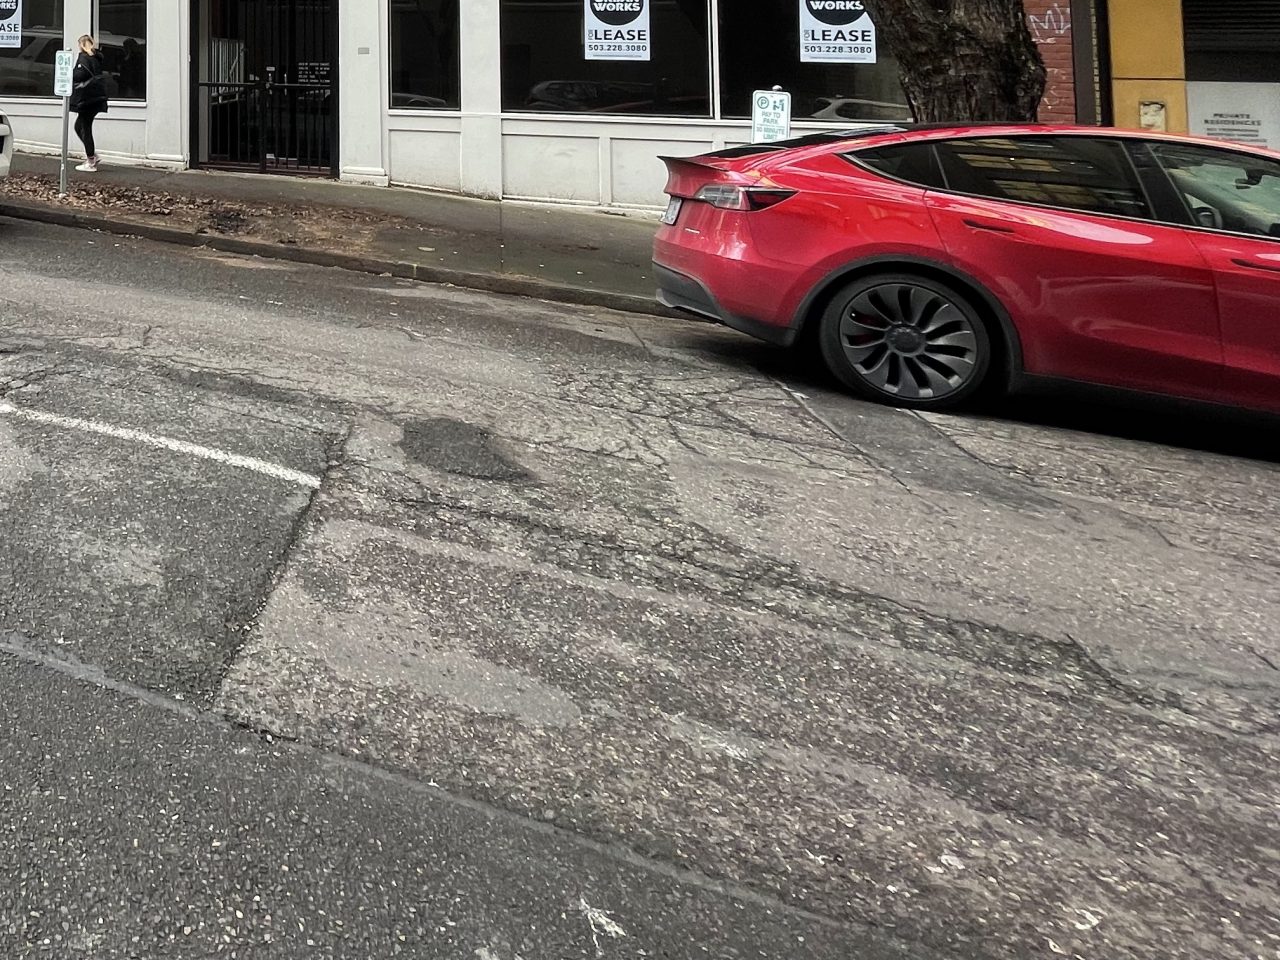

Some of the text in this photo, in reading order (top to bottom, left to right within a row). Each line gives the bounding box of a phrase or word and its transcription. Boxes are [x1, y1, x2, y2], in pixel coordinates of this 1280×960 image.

[593, 2, 641, 12] WORKS
[809, 0, 865, 10] WORKS
[594, 29, 647, 41] LEASE
[811, 29, 872, 42] LEASE
[588, 44, 647, 52] 503.228.3080
[804, 45, 872, 54] 503.228.3080
